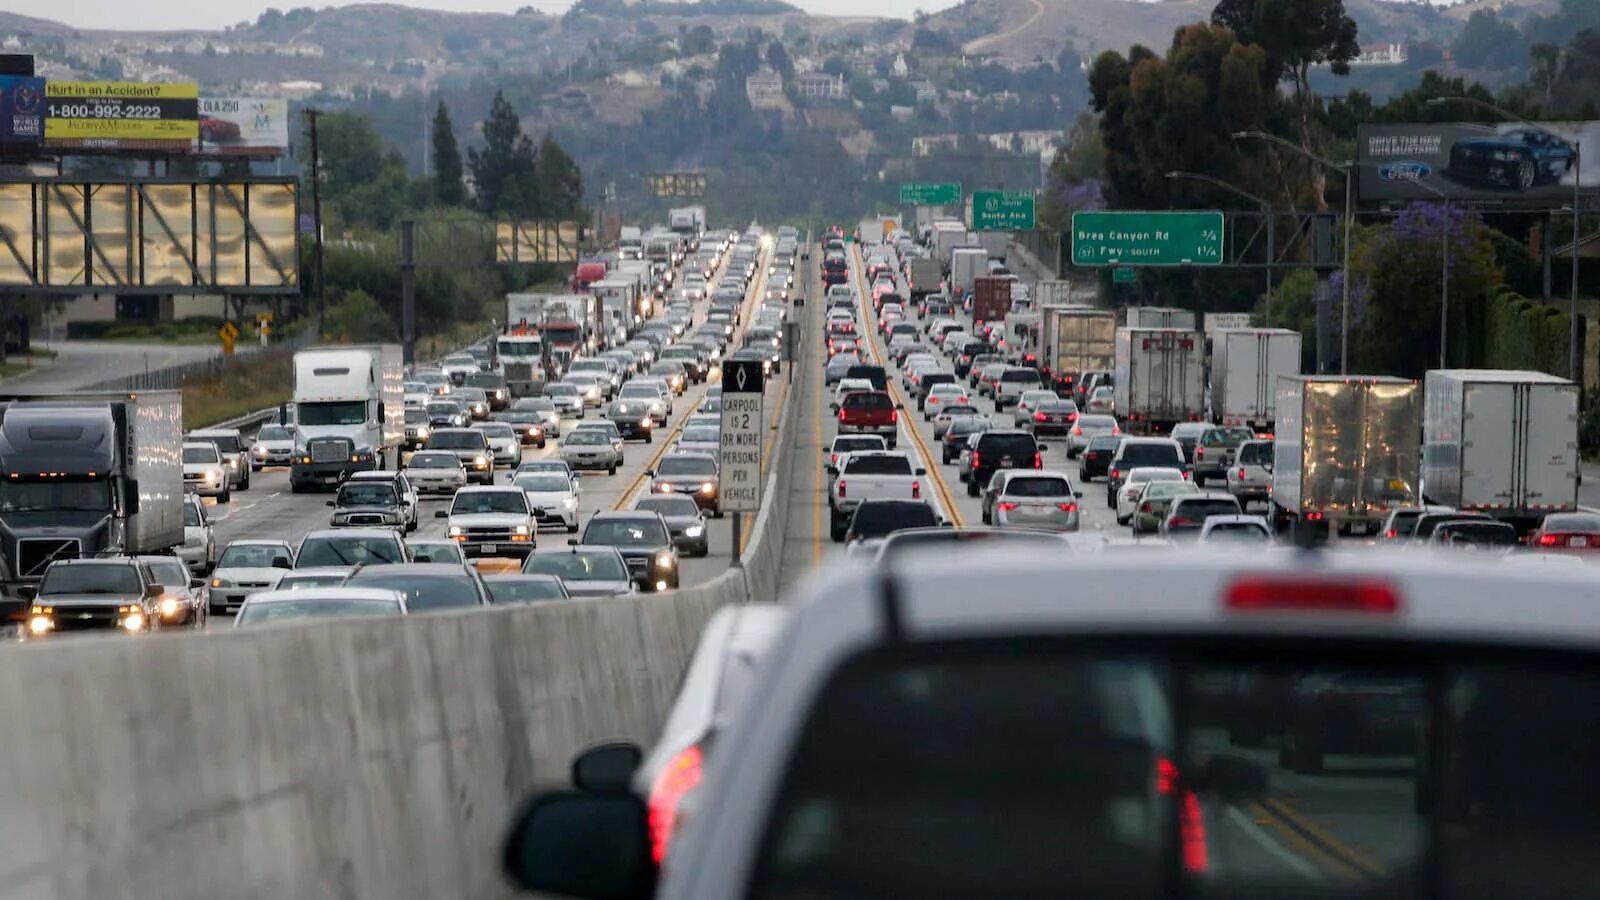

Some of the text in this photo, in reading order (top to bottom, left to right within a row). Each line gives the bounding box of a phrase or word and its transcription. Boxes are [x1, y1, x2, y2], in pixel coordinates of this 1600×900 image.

[48, 86, 71, 95] Hurt
[76, 86, 86, 95] in
[105, 86, 160, 96] Accident?
[48, 105, 160, 118] 1-800-992-2222
[222, 100, 239, 113] 250
[1368, 136, 1398, 145] DRIVE
[1419, 136, 1441, 145] NEW
[981, 212, 1026, 220] Santa Ana
[1078, 231, 1104, 241] Brea
[1109, 231, 1150, 243] Canyon
[1155, 231, 1169, 241] Rd
[1100, 247, 1123, 257] Fwy
[724, 399, 759, 411] CARPOOL
[731, 414, 750, 429] IS 2
[722, 433, 759, 446] OR MORE
[722, 452, 759, 464] PERSONS
[732, 470, 748, 481] PER
[724, 487, 756, 500] VEHICLE
